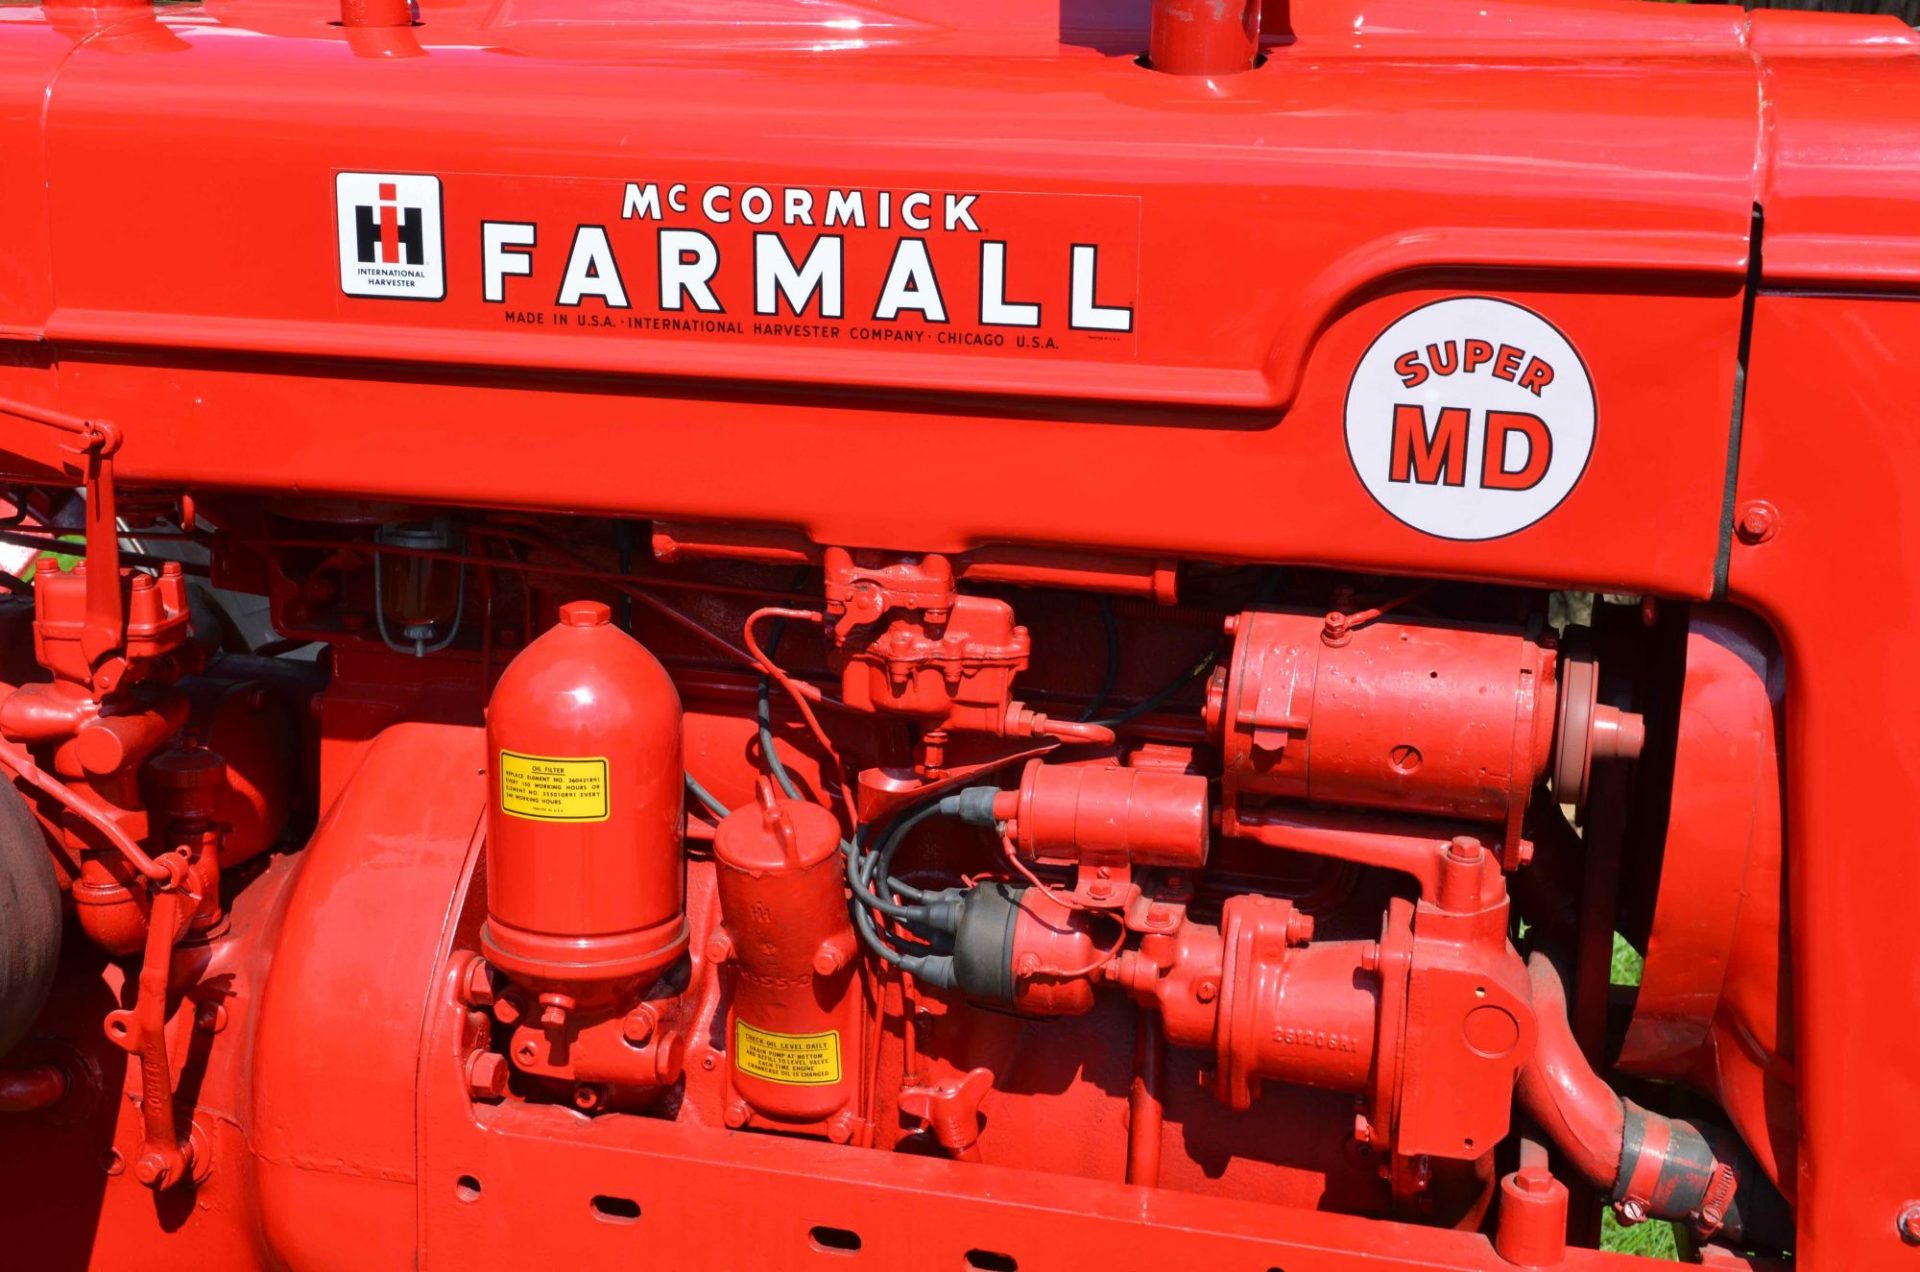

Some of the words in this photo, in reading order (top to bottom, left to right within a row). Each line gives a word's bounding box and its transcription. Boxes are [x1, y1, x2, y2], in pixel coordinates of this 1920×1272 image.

[357, 267, 425, 279] INTERNATIONAL
[480, 220, 1134, 333] FARMALL
[368, 278, 416, 287] HARVESTER
[505, 312, 545, 325] MADE
[554, 314, 569, 326] IN
[577, 315, 616, 328] U.S.A.
[628, 317, 744, 335] INTERNATIONAL
[753, 322, 840, 339] HARVESTER
[850, 327, 924, 343] COMPANY
[937, 331, 1005, 347] CHICAGO
[1016, 335, 1060, 350] U.S.A.
[1393, 338, 1555, 398] SUPER
[1388, 402, 1554, 492] MD
[505, 770, 524, 779] REPLACE
[505, 777, 518, 785] EVERY
[515, 795, 540, 803] WORKING
[745, 1033, 764, 1044] CHECK
[805, 1042, 828, 1050] DAILY
[750, 1045, 767, 1054] DRAIN
[757, 1053, 776, 1062] REFILL
[800, 1070, 830, 1078] CHANGED
